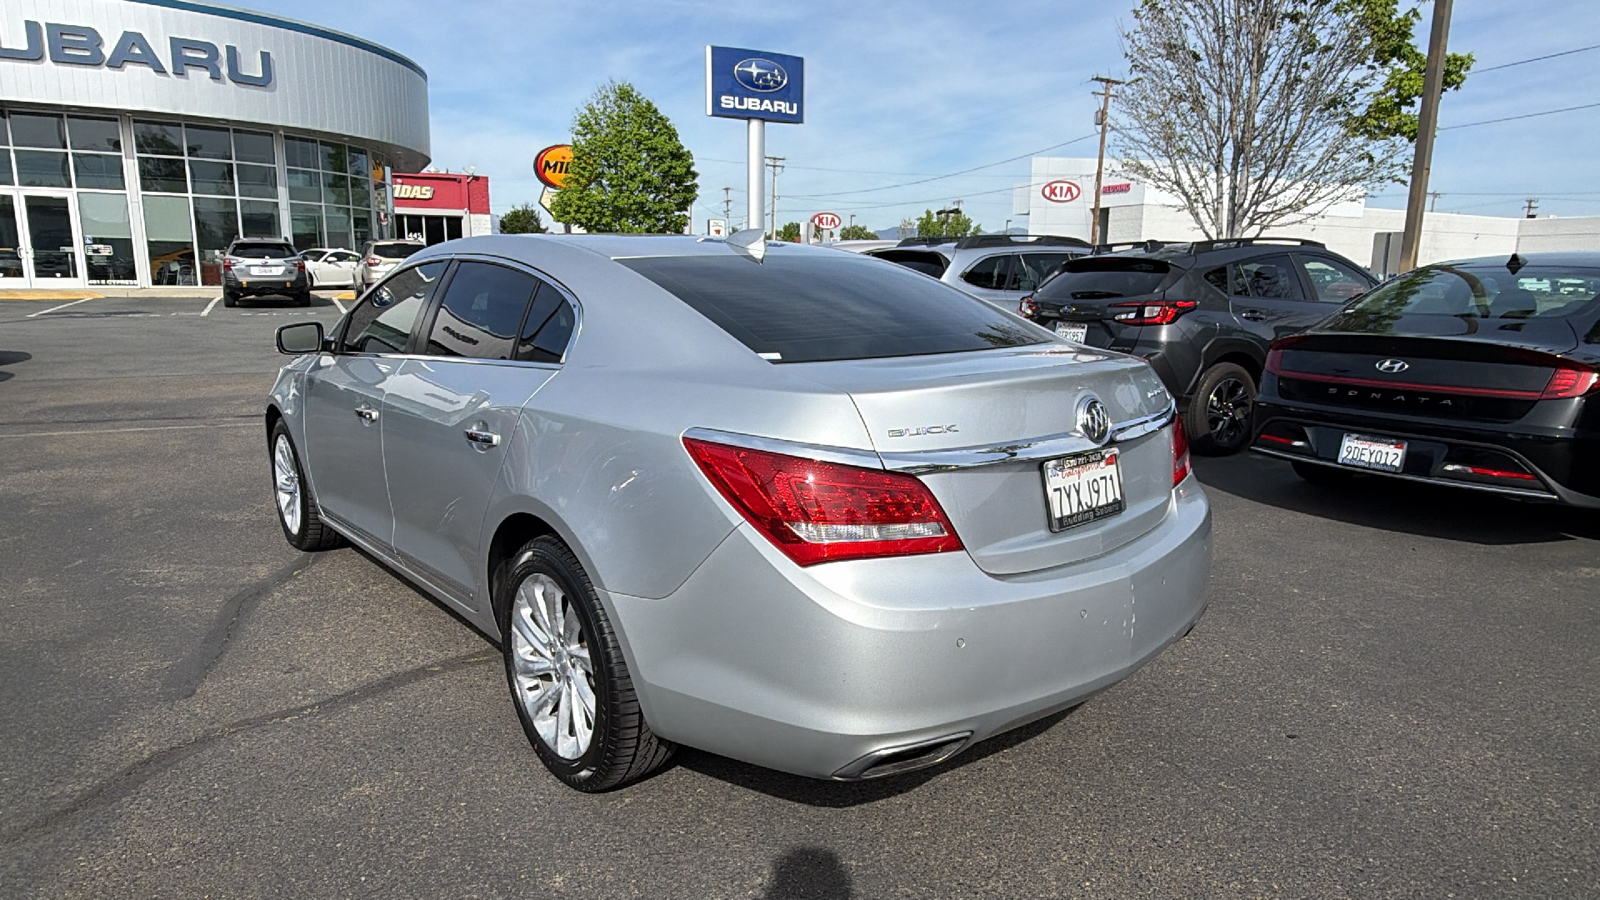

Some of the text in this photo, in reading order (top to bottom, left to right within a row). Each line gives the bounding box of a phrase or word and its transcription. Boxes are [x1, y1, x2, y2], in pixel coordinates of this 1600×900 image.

[0, 20, 274, 87] UBARU
[720, 95, 798, 115] SUBARU
[392, 179, 435, 199] IDAS
[1048, 185, 1075, 199] KIA
[1102, 183, 1131, 194] REDDING
[816, 217, 837, 227] KIA
[1328, 388, 1452, 405] SONATA
[887, 424, 959, 438] BUICK
[1342, 445, 1399, 467] 9DEY012
[1052, 474, 1118, 517] 7YXJ971
